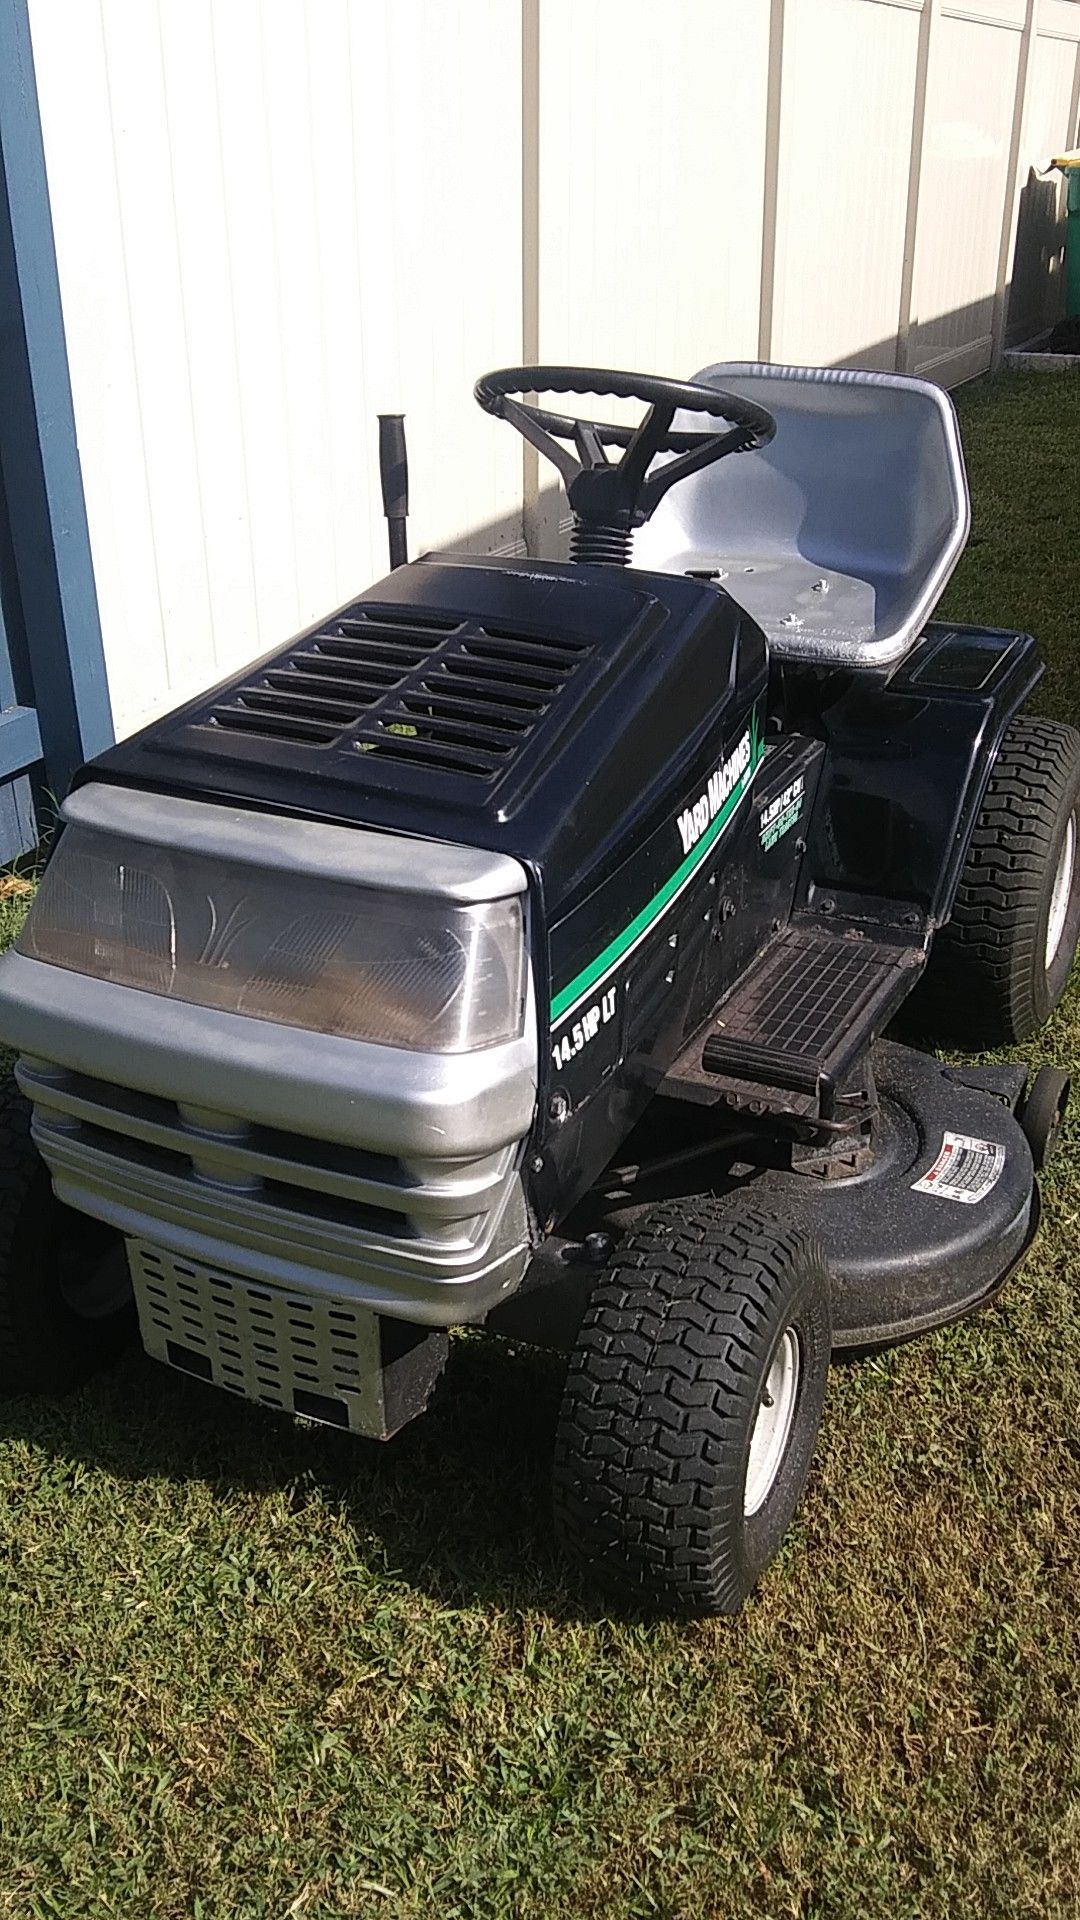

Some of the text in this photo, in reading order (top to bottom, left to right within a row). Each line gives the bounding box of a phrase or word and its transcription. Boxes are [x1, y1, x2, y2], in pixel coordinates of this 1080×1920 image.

[677, 730, 751, 855] YARD MACHINES
[602, 986, 616, 1024] LT
